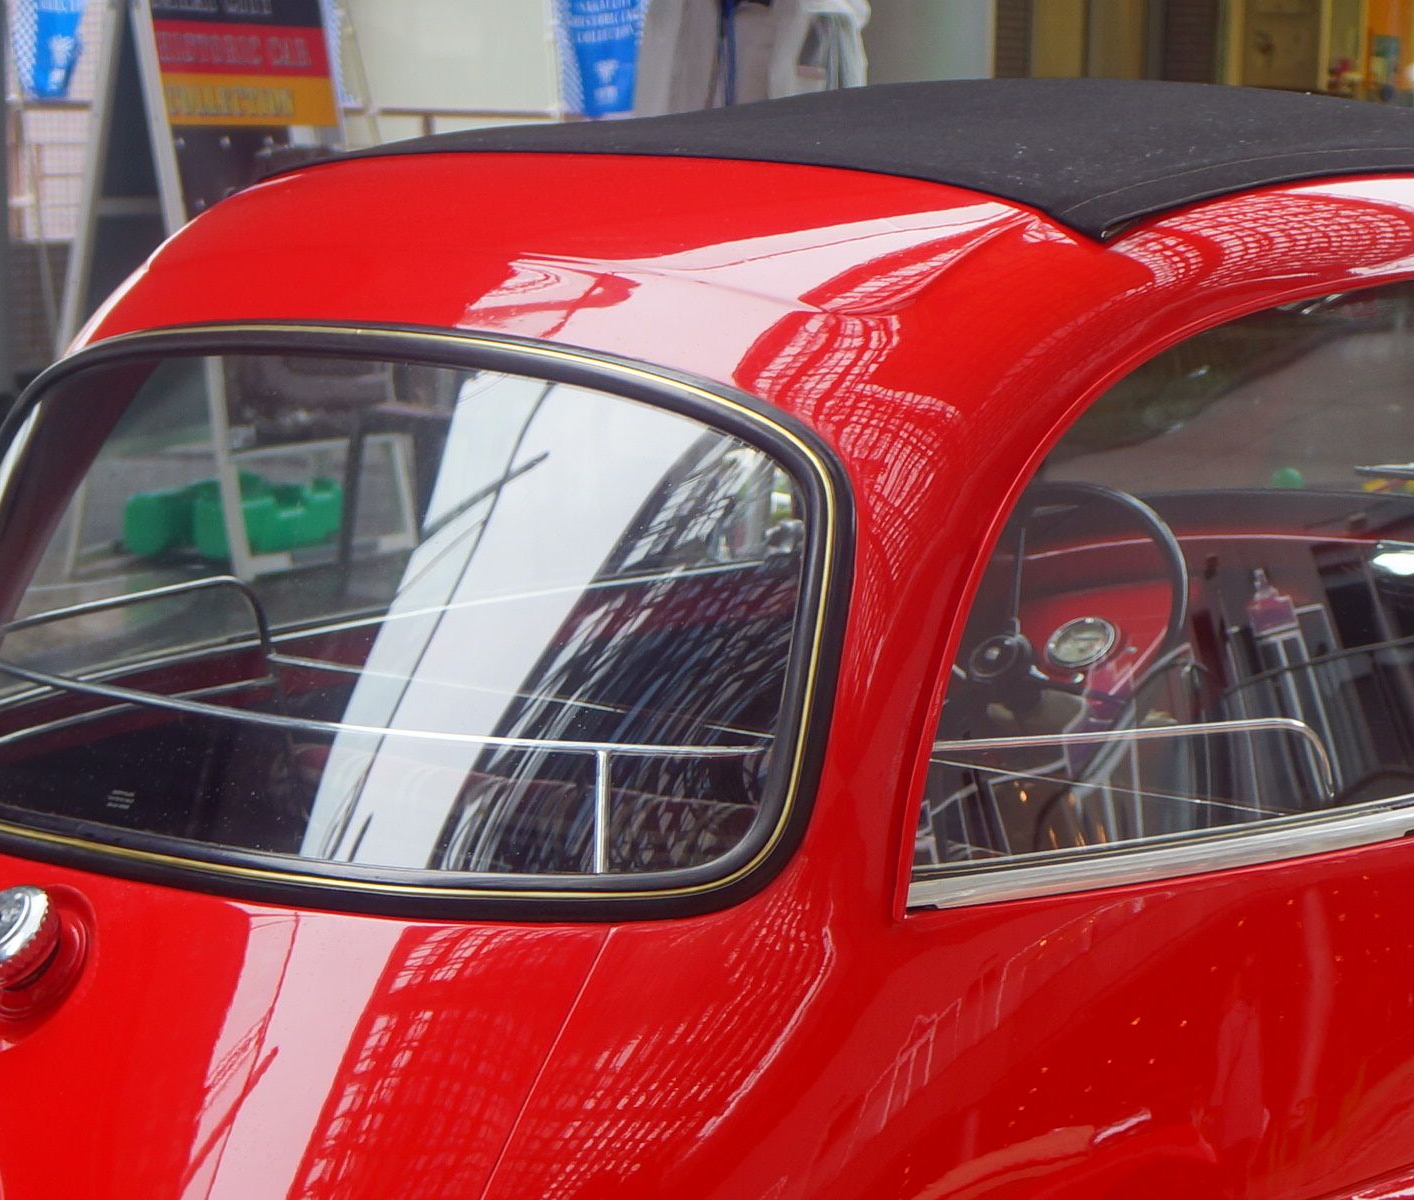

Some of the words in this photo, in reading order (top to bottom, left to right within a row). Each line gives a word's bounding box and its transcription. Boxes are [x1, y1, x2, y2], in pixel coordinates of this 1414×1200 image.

[156, 31, 263, 66] HISTORIC
[267, 35, 312, 68] CAR
[165, 84, 295, 117] COLLECTION
